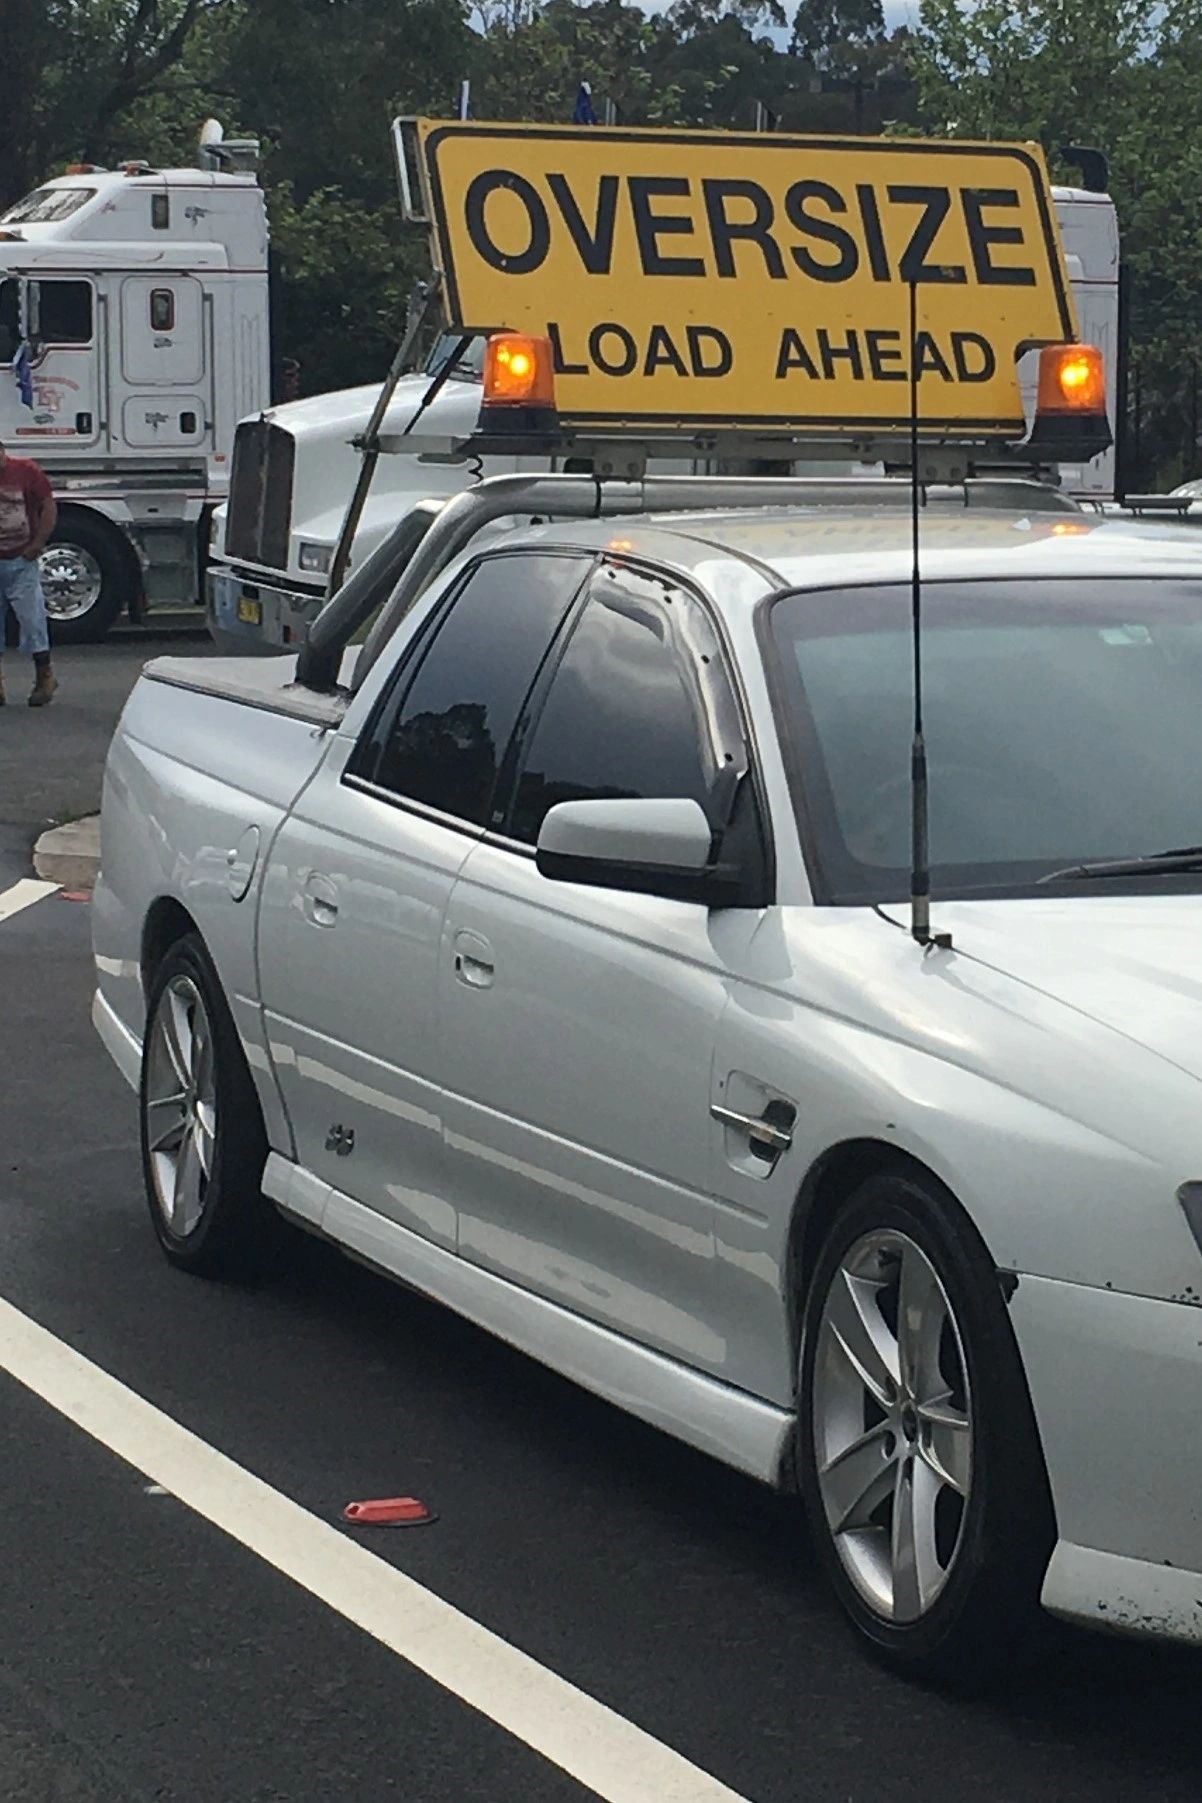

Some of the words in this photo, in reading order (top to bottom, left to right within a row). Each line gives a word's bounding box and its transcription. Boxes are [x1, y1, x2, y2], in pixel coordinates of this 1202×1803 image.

[463, 168, 1038, 288] OVERSIZE
[546, 321, 734, 379] LOAD
[774, 326, 997, 384] AHEAD
